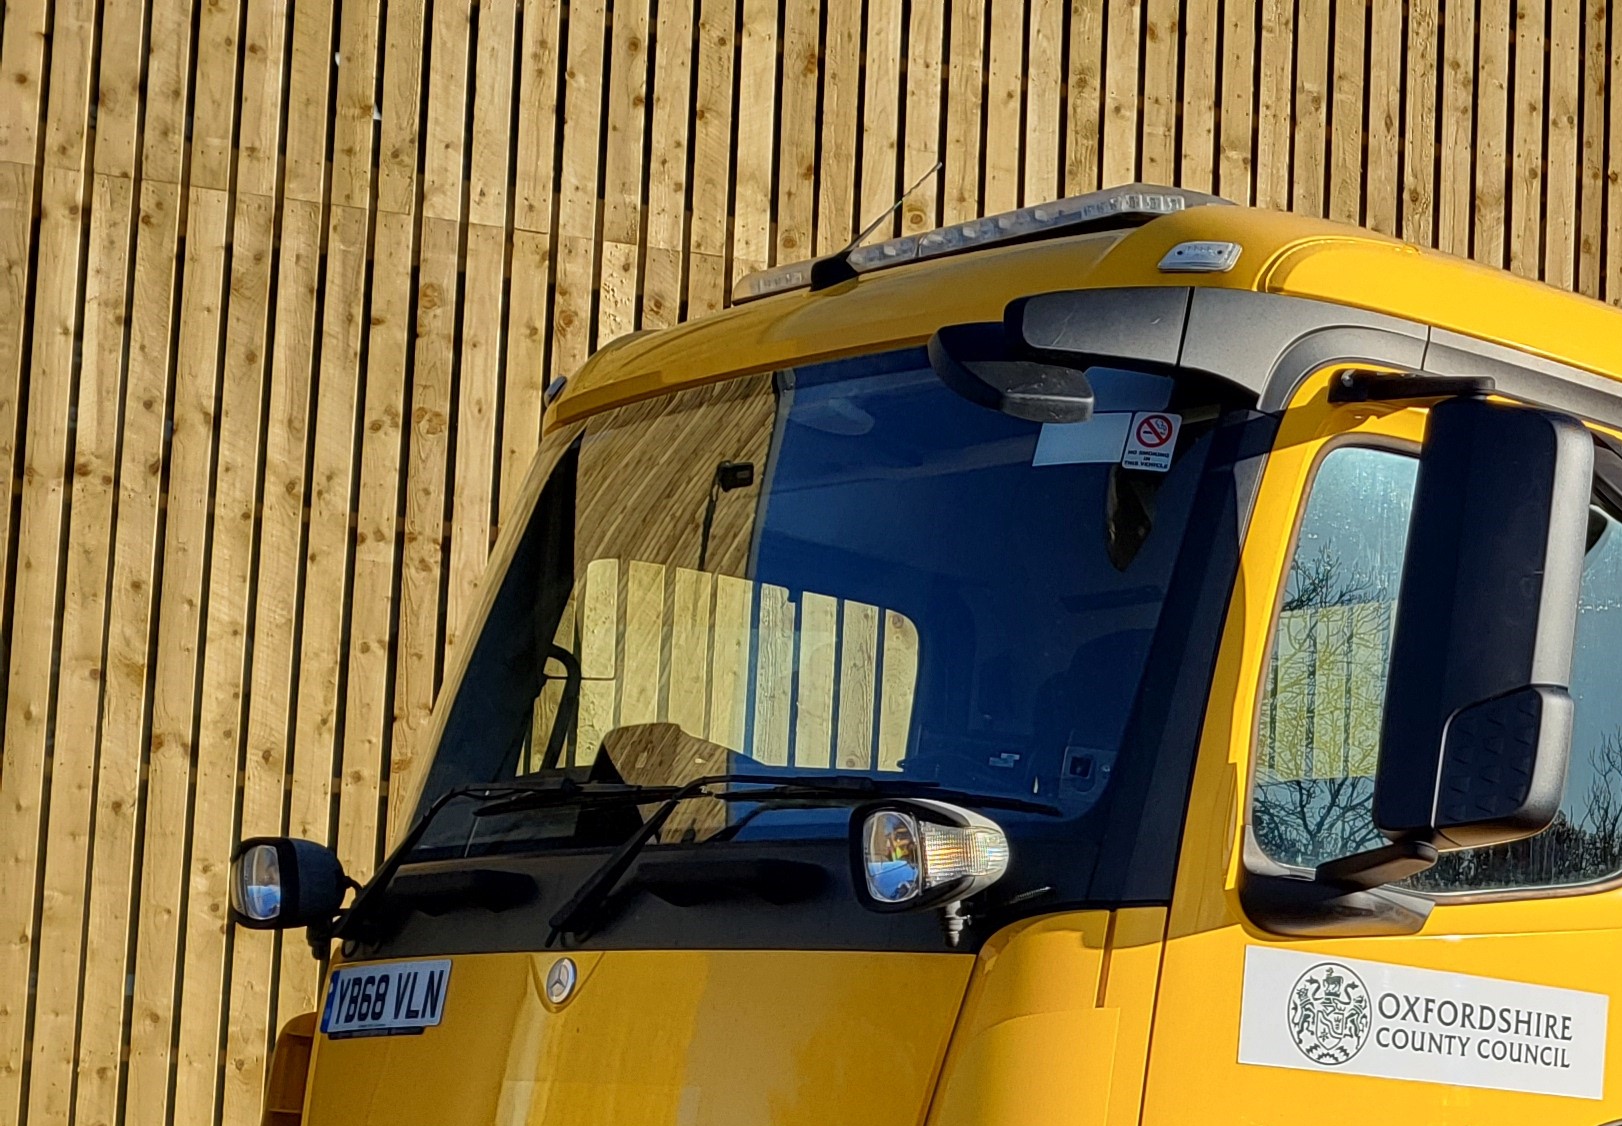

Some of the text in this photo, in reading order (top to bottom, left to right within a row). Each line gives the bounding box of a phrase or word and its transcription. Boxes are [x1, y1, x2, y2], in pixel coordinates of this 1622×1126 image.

[1140, 461, 1168, 469] VEHICLE
[334, 969, 445, 1025] YB68 VLN
[1377, 992, 1573, 1041] OXFORDSHIRE
[1375, 1026, 1571, 1069] COUNTY COUNCIL
